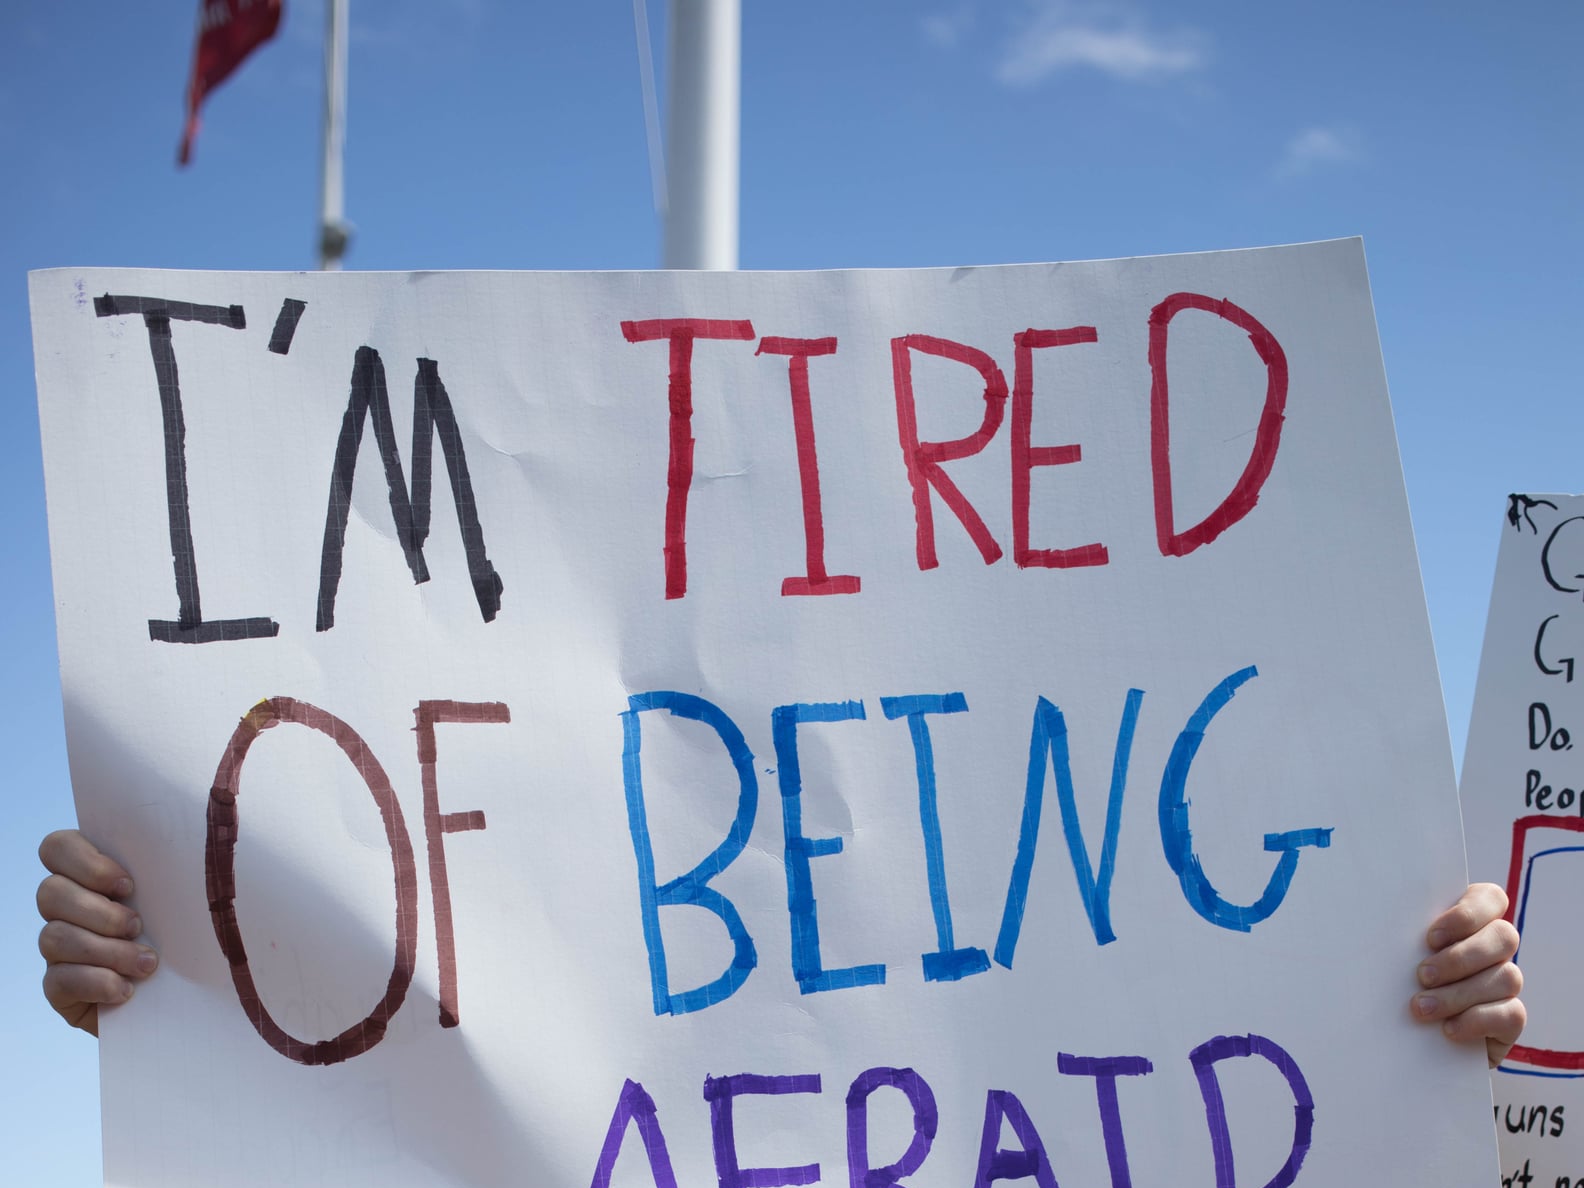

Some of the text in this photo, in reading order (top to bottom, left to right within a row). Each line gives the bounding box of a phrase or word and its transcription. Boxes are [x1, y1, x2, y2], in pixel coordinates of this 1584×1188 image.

[94, 292, 1289, 644] I'M TIRED
[205, 665, 1334, 1065] OF BEING
[1526, 769, 1584, 817] Peo
[1493, 1104, 1564, 1138] uns
